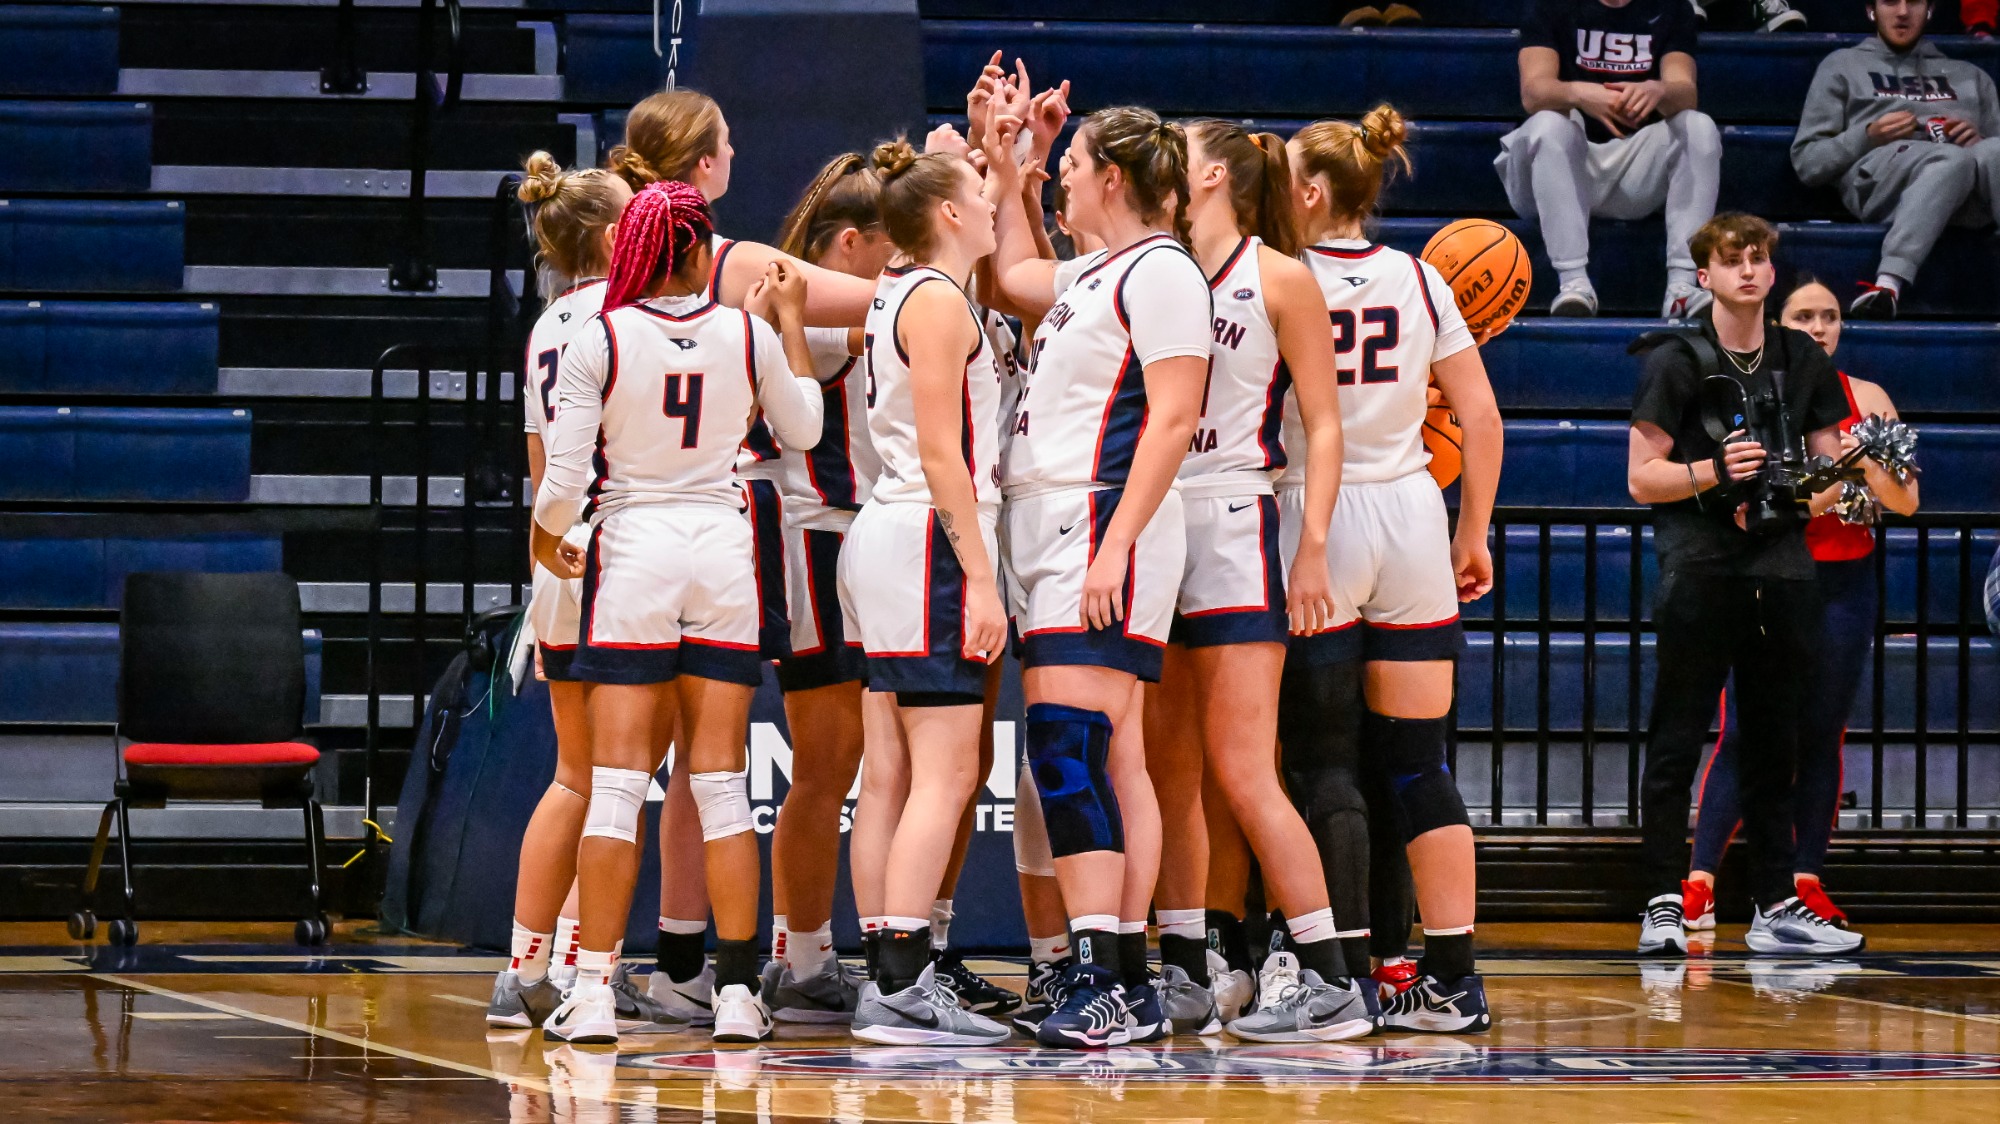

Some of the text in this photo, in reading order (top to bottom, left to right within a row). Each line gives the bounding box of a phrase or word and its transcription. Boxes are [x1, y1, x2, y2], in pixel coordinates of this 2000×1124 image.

[1577, 29, 1653, 62] USI
[1329, 305, 1400, 386] 22
[662, 373, 704, 449] 4
